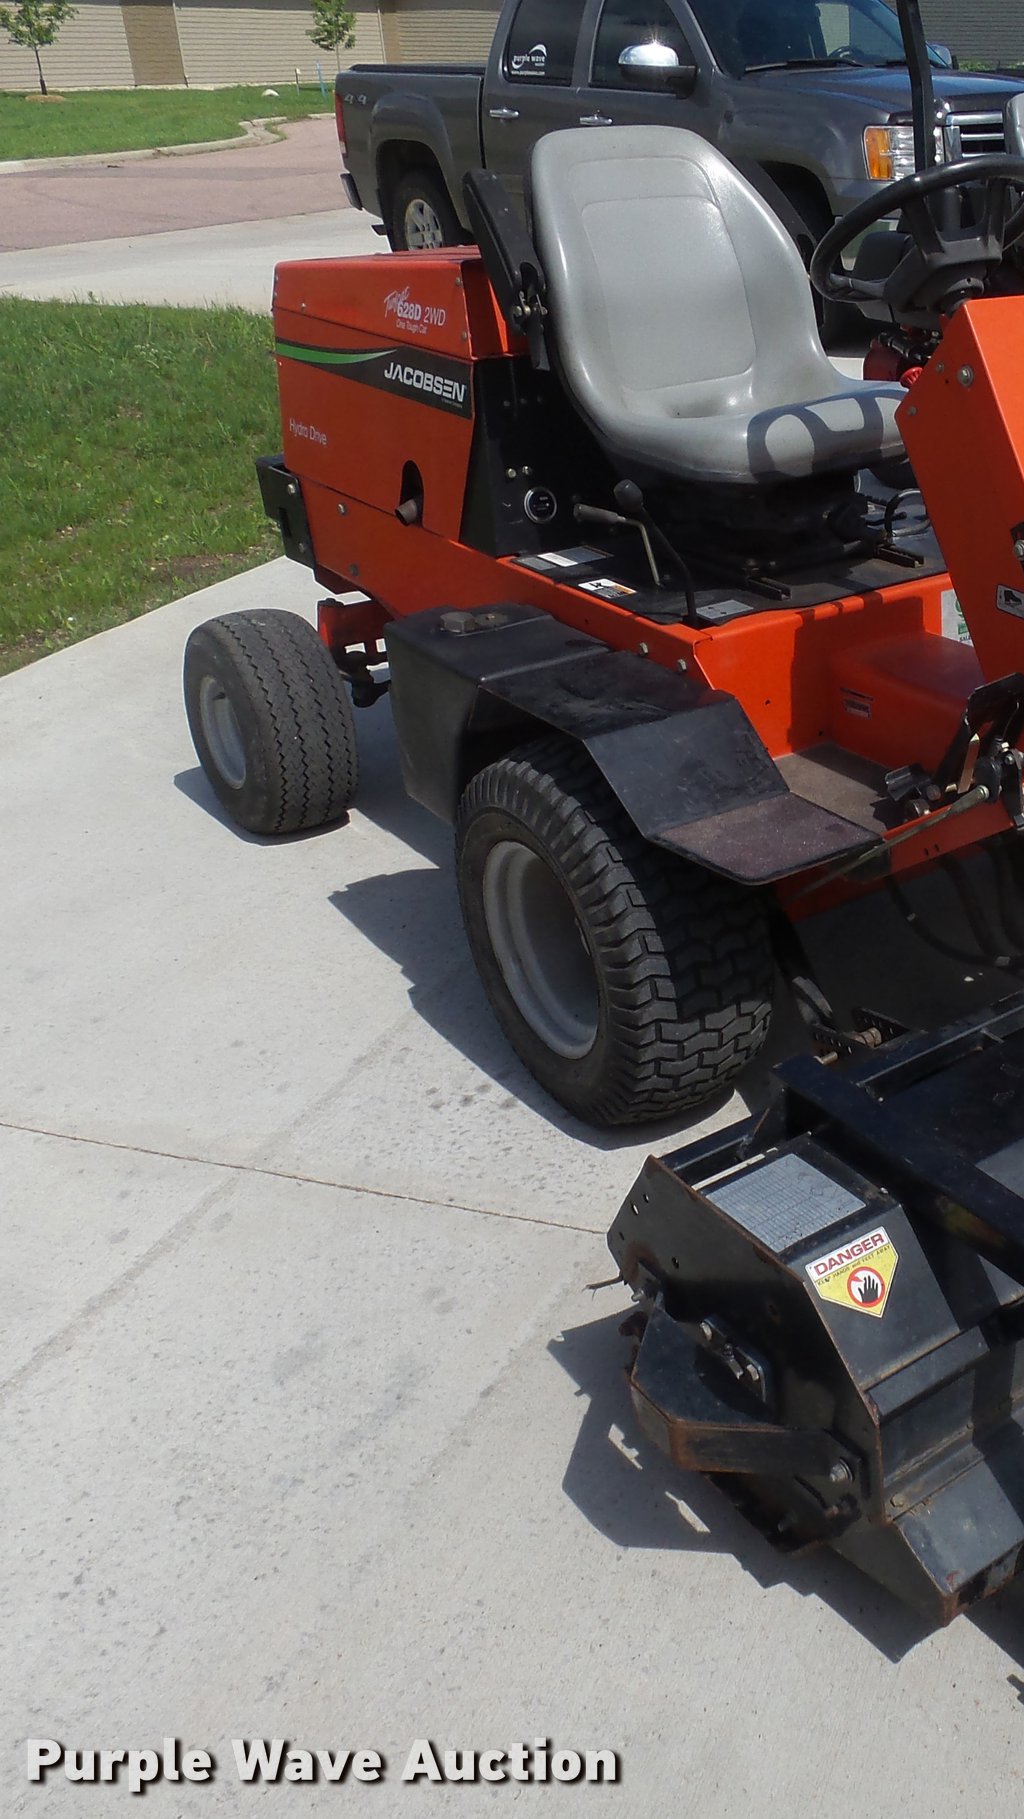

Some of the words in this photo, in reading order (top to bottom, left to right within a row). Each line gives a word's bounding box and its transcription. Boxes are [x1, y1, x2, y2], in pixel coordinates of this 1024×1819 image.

[397, 301, 422, 320] 628D
[423, 306, 446, 327] 2WD
[384, 362, 465, 402] JACOBSEN
[289, 417, 309, 438] Hydro
[310, 425, 327, 445] Drive
[814, 1233, 885, 1276] DANGER
